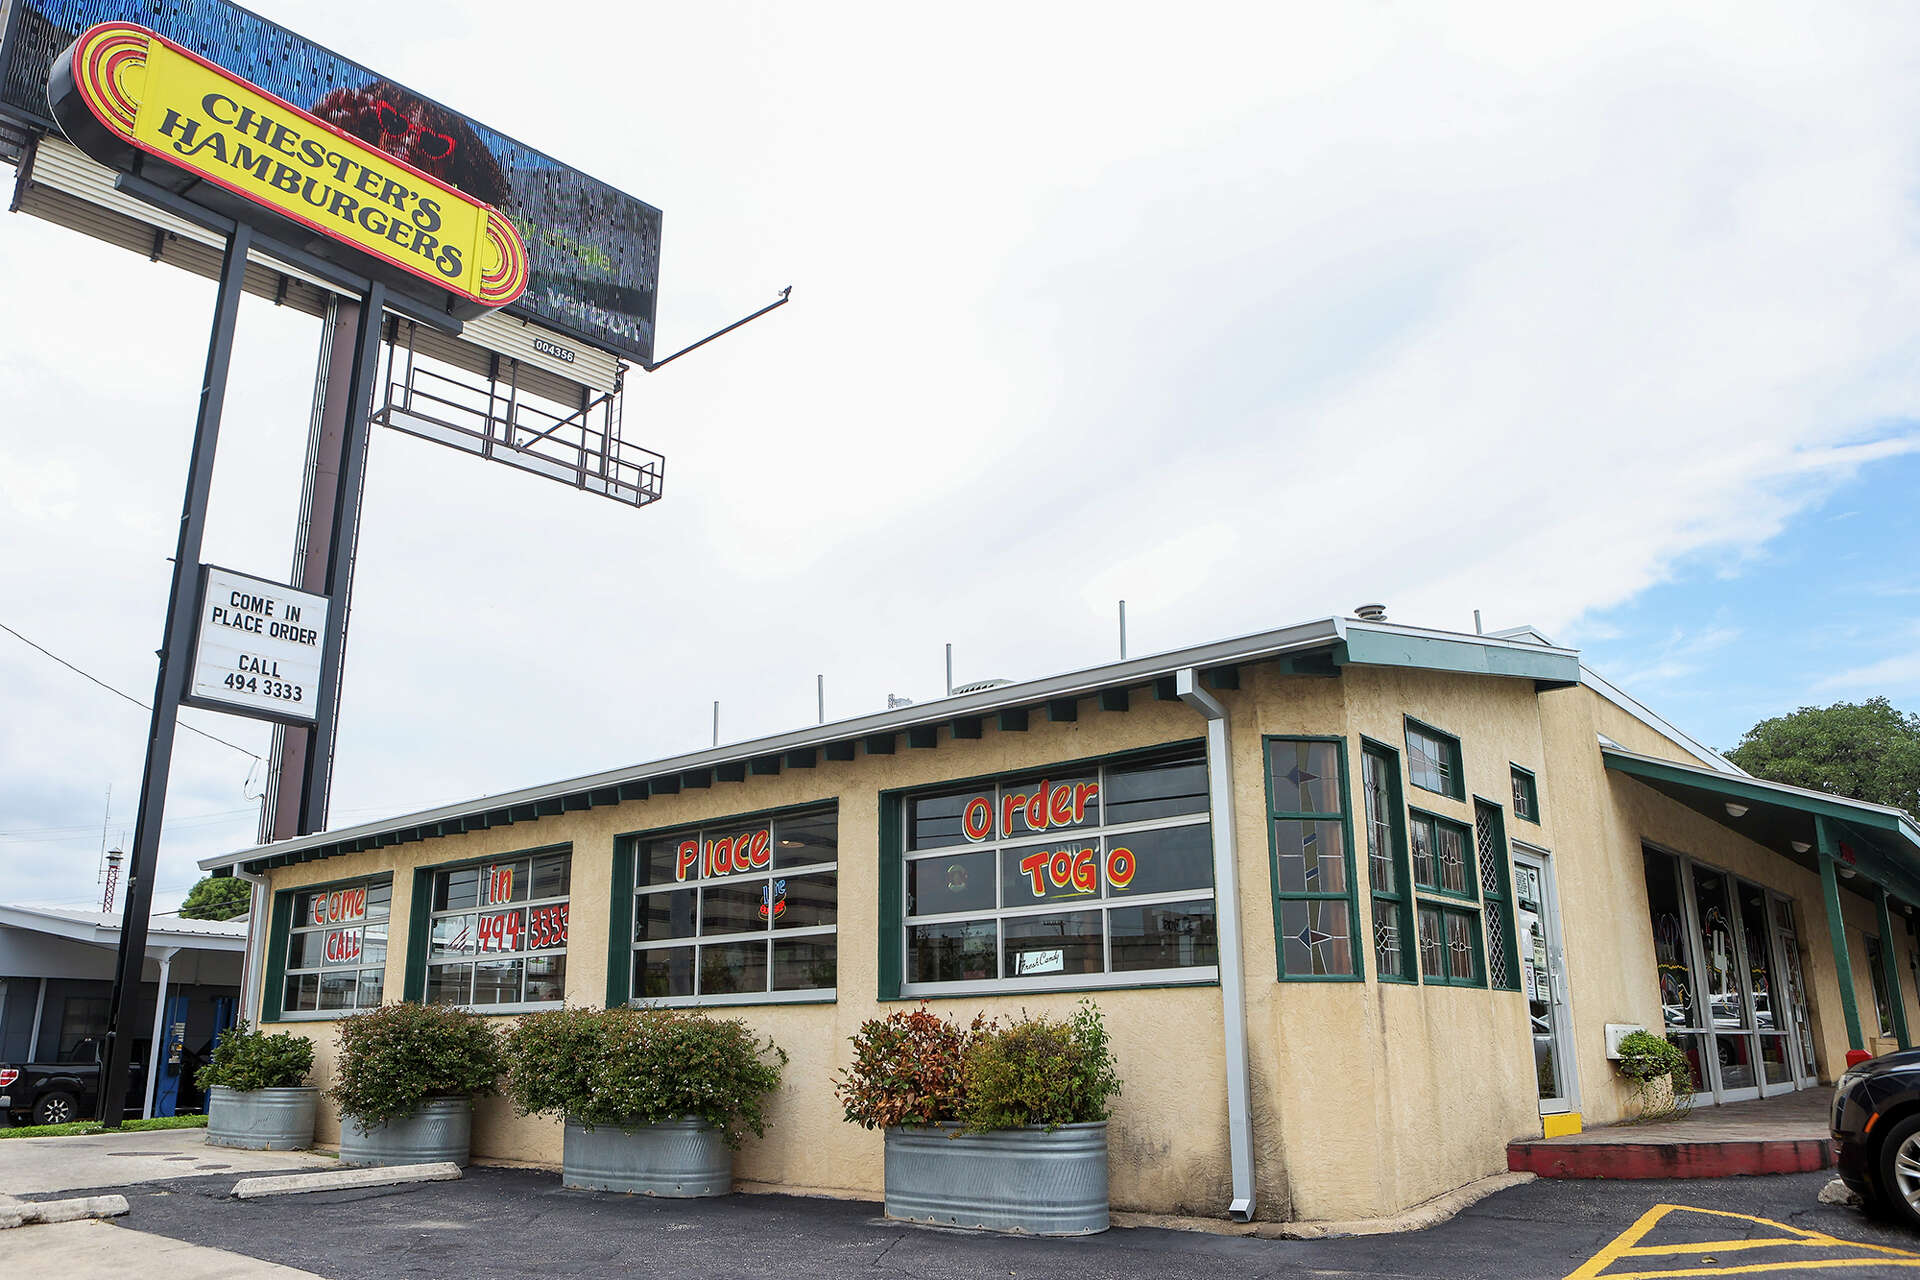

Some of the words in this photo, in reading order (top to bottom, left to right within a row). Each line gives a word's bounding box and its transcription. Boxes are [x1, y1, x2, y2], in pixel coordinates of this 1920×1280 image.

[202, 93, 442, 233] CHESTER'S
[157, 108, 463, 278] HAMBURGERS
[536, 340, 574, 362] 004356
[212, 606, 263, 634] PLACE
[269, 621, 317, 646] ORDER
[230, 591, 274, 616] COME
[285, 604, 301, 622] IN
[238, 654, 281, 678] CALL
[224, 672, 257, 693] 494
[263, 679, 303, 701] 3333
[962, 779, 1099, 843] Order
[676, 829, 770, 882] Place
[489, 863, 513, 904] in
[326, 930, 360, 962] CALL
